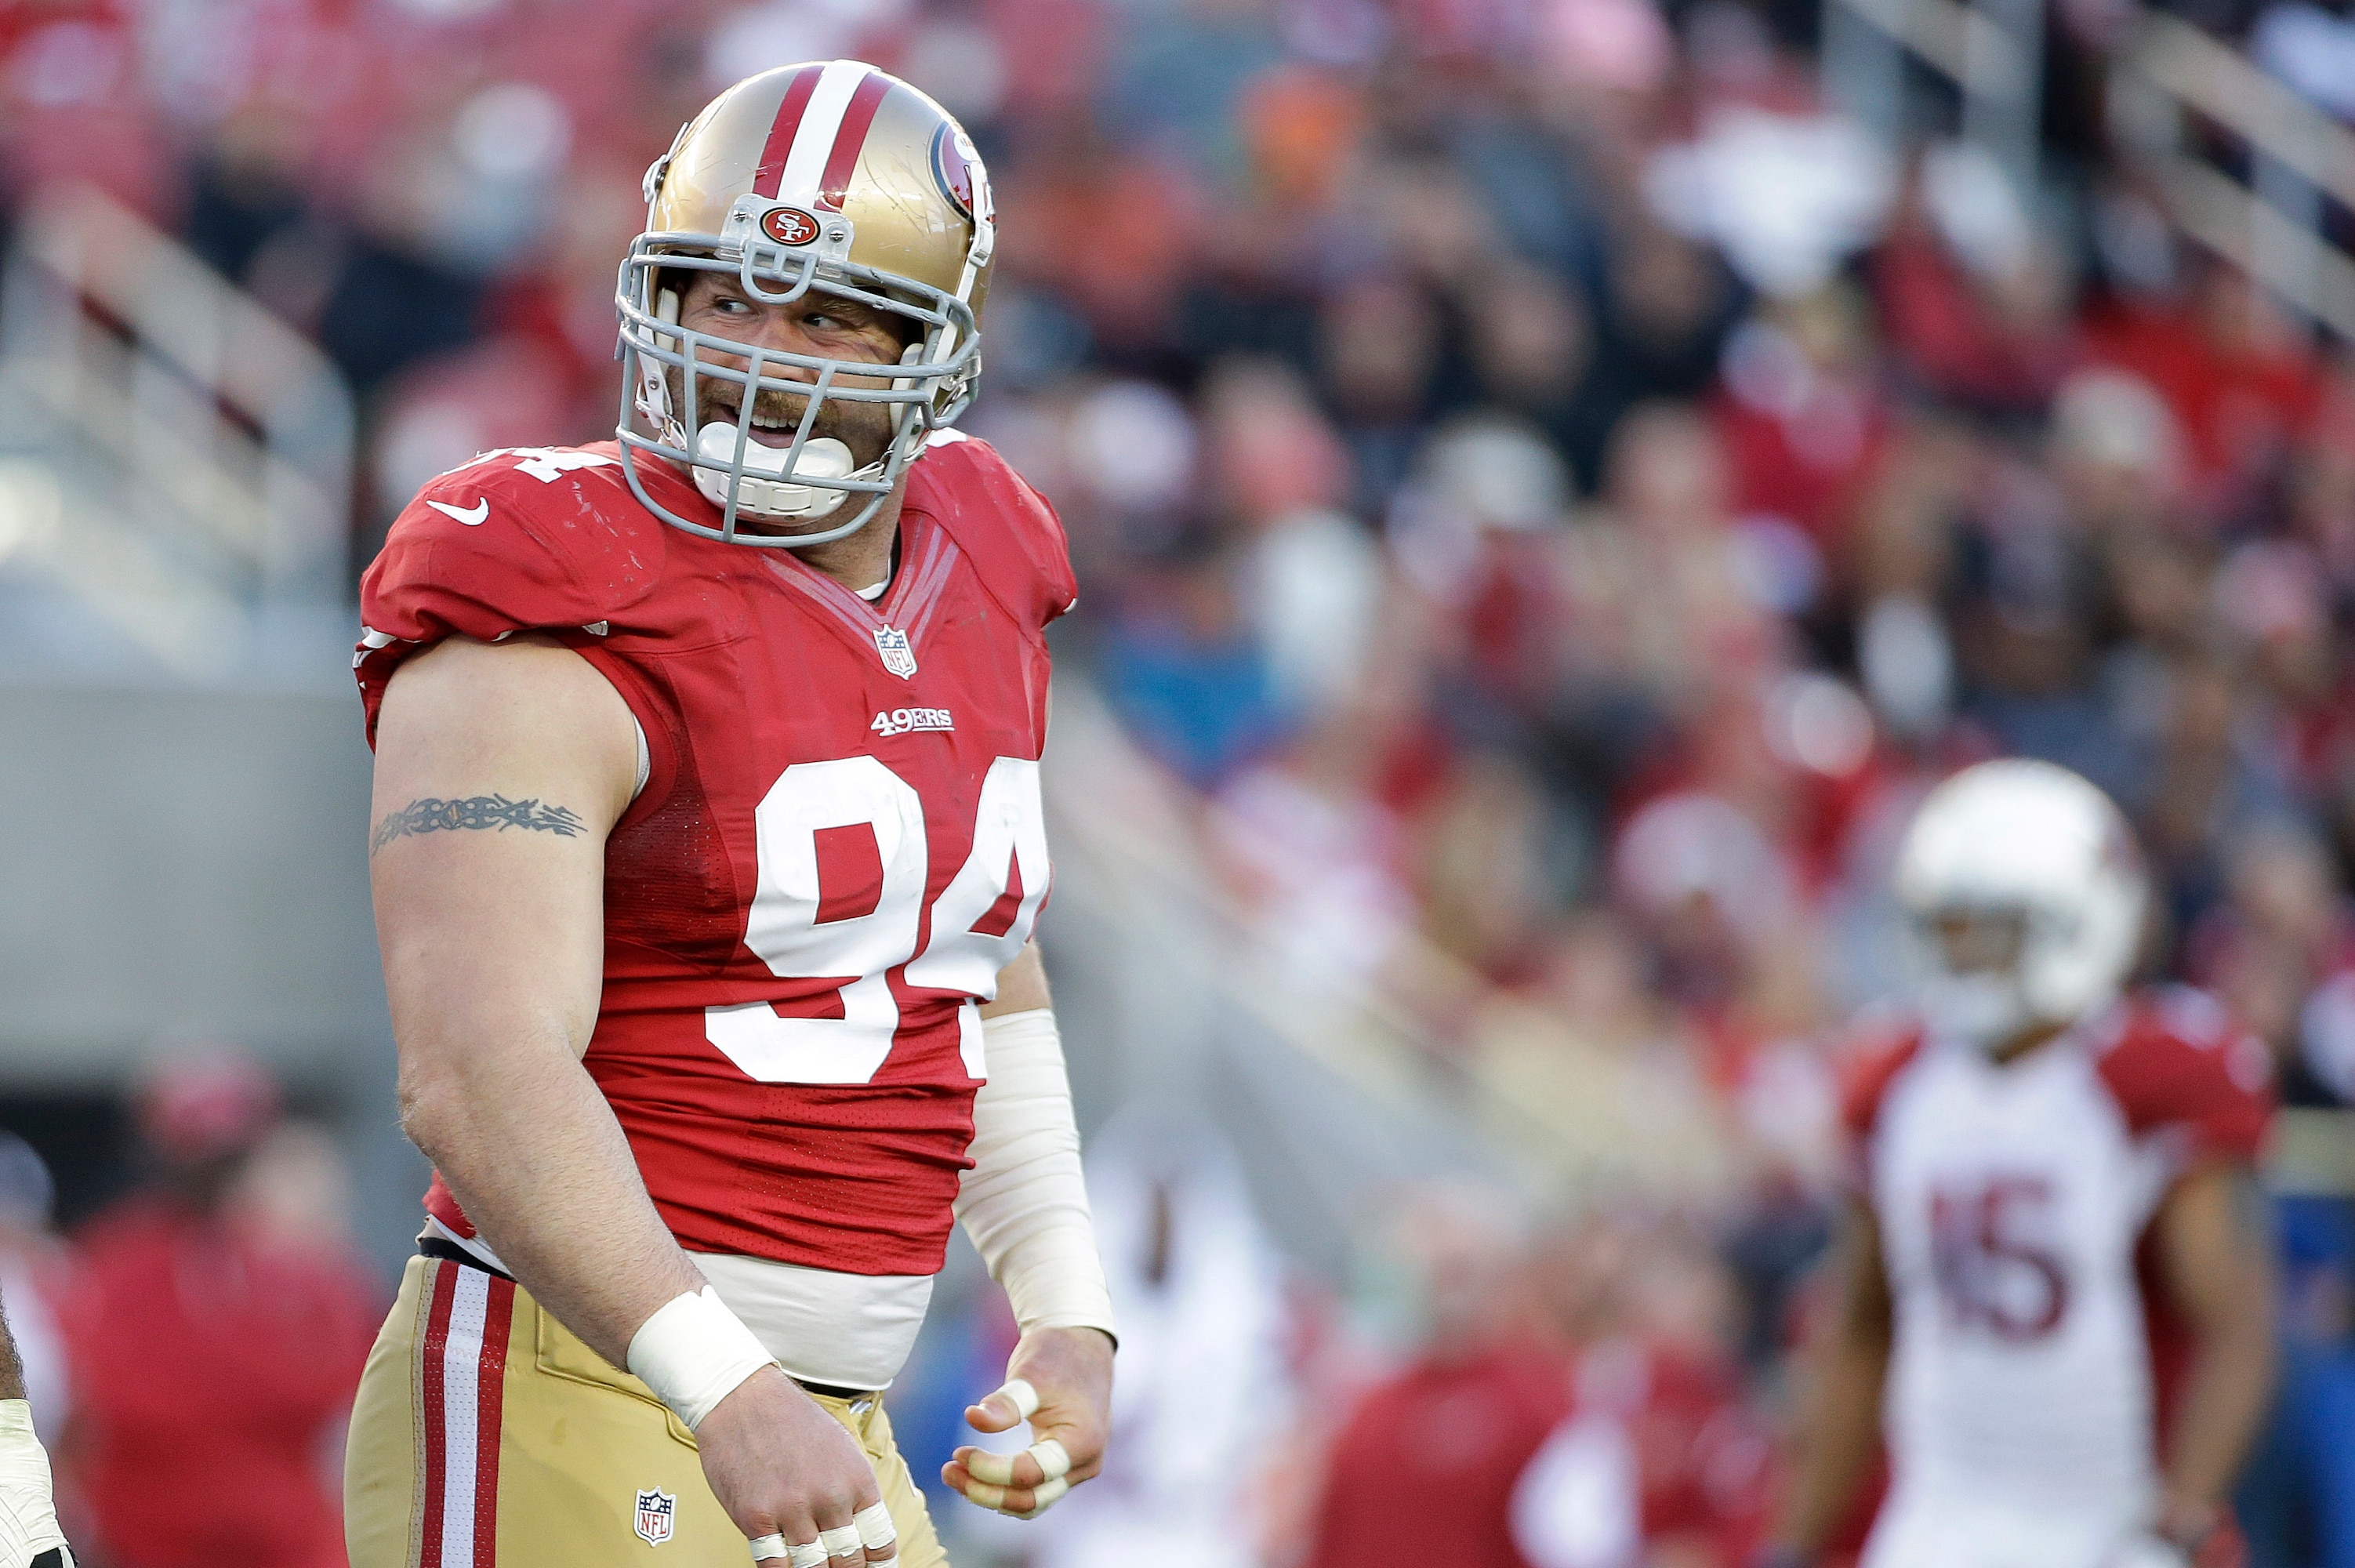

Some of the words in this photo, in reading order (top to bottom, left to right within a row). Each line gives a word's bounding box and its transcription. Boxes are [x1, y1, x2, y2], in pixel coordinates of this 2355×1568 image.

[775, 213, 810, 241] SF
[884, 650, 910, 670] NFL
[870, 708, 956, 737] 49ERS
[705, 754, 1050, 1083] 94
[640, 1512, 666, 1536] NFL
